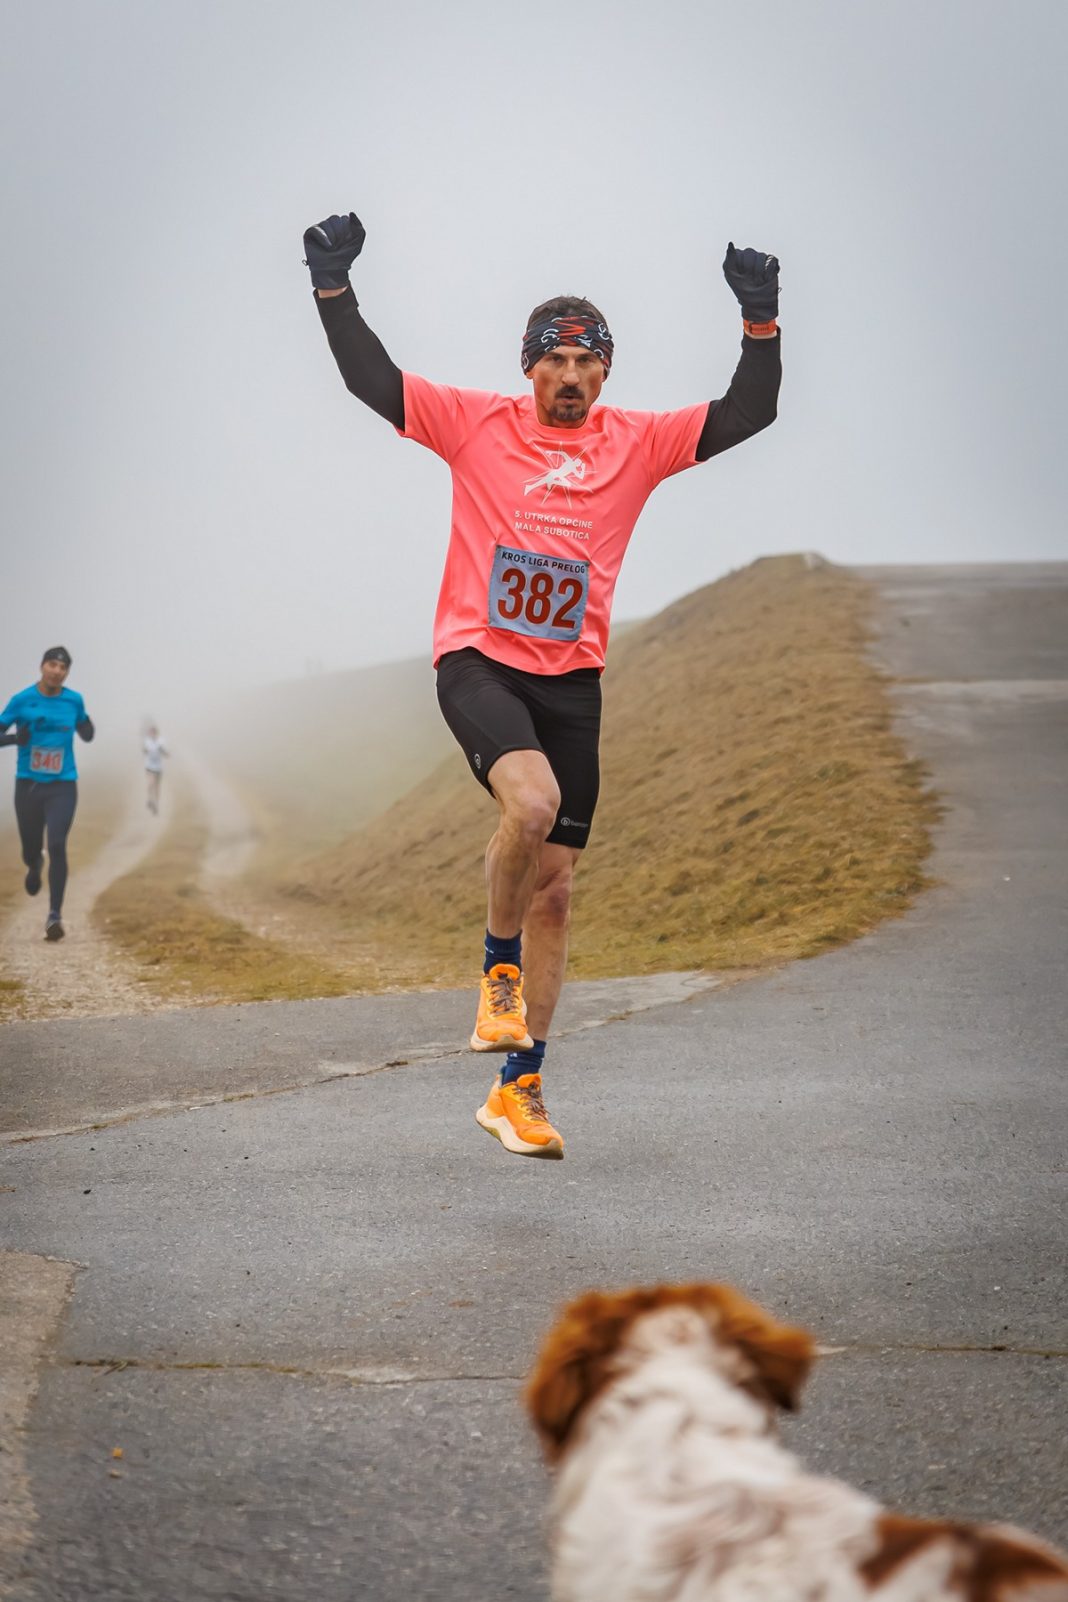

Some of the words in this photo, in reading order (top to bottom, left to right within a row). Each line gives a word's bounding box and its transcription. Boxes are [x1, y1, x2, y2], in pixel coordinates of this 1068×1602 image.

[514, 510, 522, 519] 5.
[524, 511, 556, 524] UTRKA
[514, 522, 541, 533] MALA
[543, 526, 590, 540] SUBOTICA
[501, 551, 526, 563] KROS
[528, 556, 549, 567] LIGA
[551, 561, 585, 574] PRELOG
[497, 567, 583, 629] 382
[31, 751, 62, 771] 340
